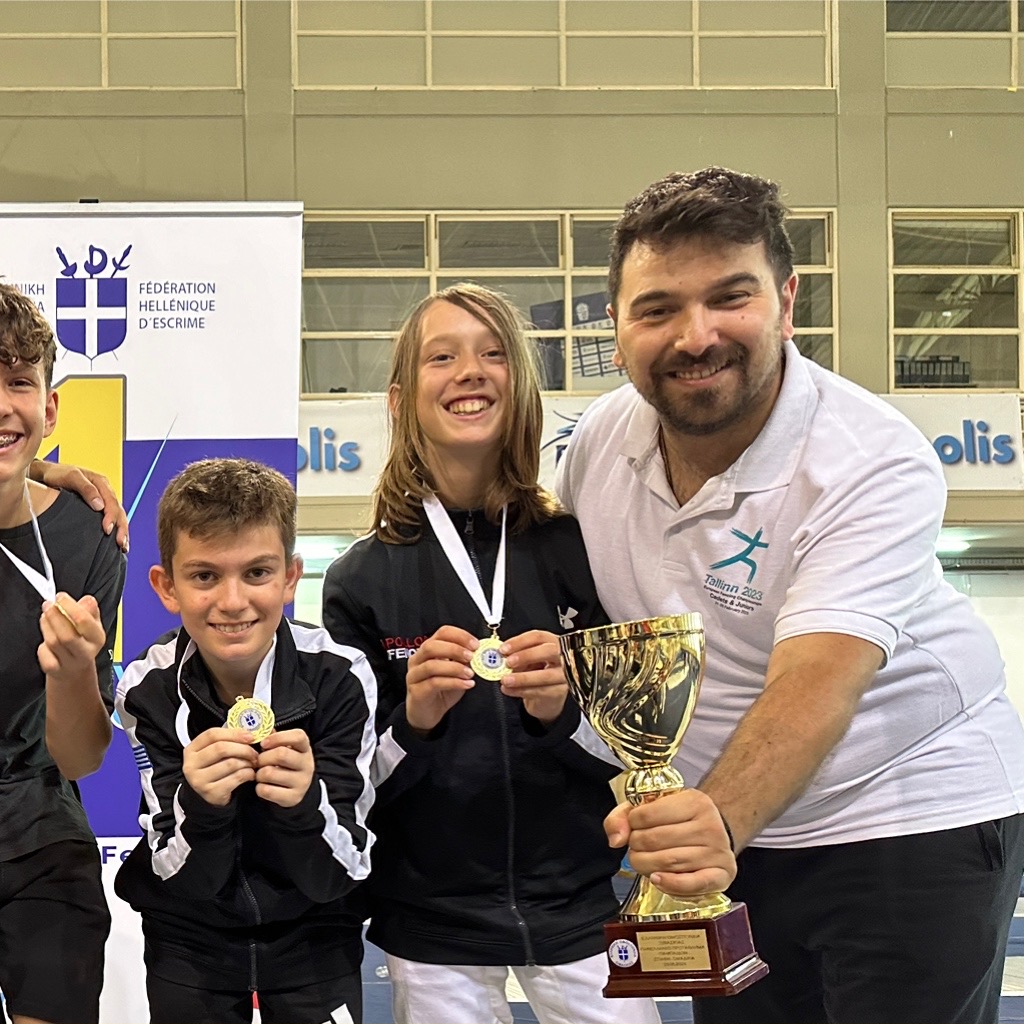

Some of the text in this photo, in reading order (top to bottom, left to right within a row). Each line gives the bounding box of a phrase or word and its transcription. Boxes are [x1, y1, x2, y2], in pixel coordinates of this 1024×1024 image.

[139, 280, 216, 295] FÉDÉRATION
[139, 298, 216, 312] HELLÉNIQUE
[704, 573, 739, 593] Tallinn
